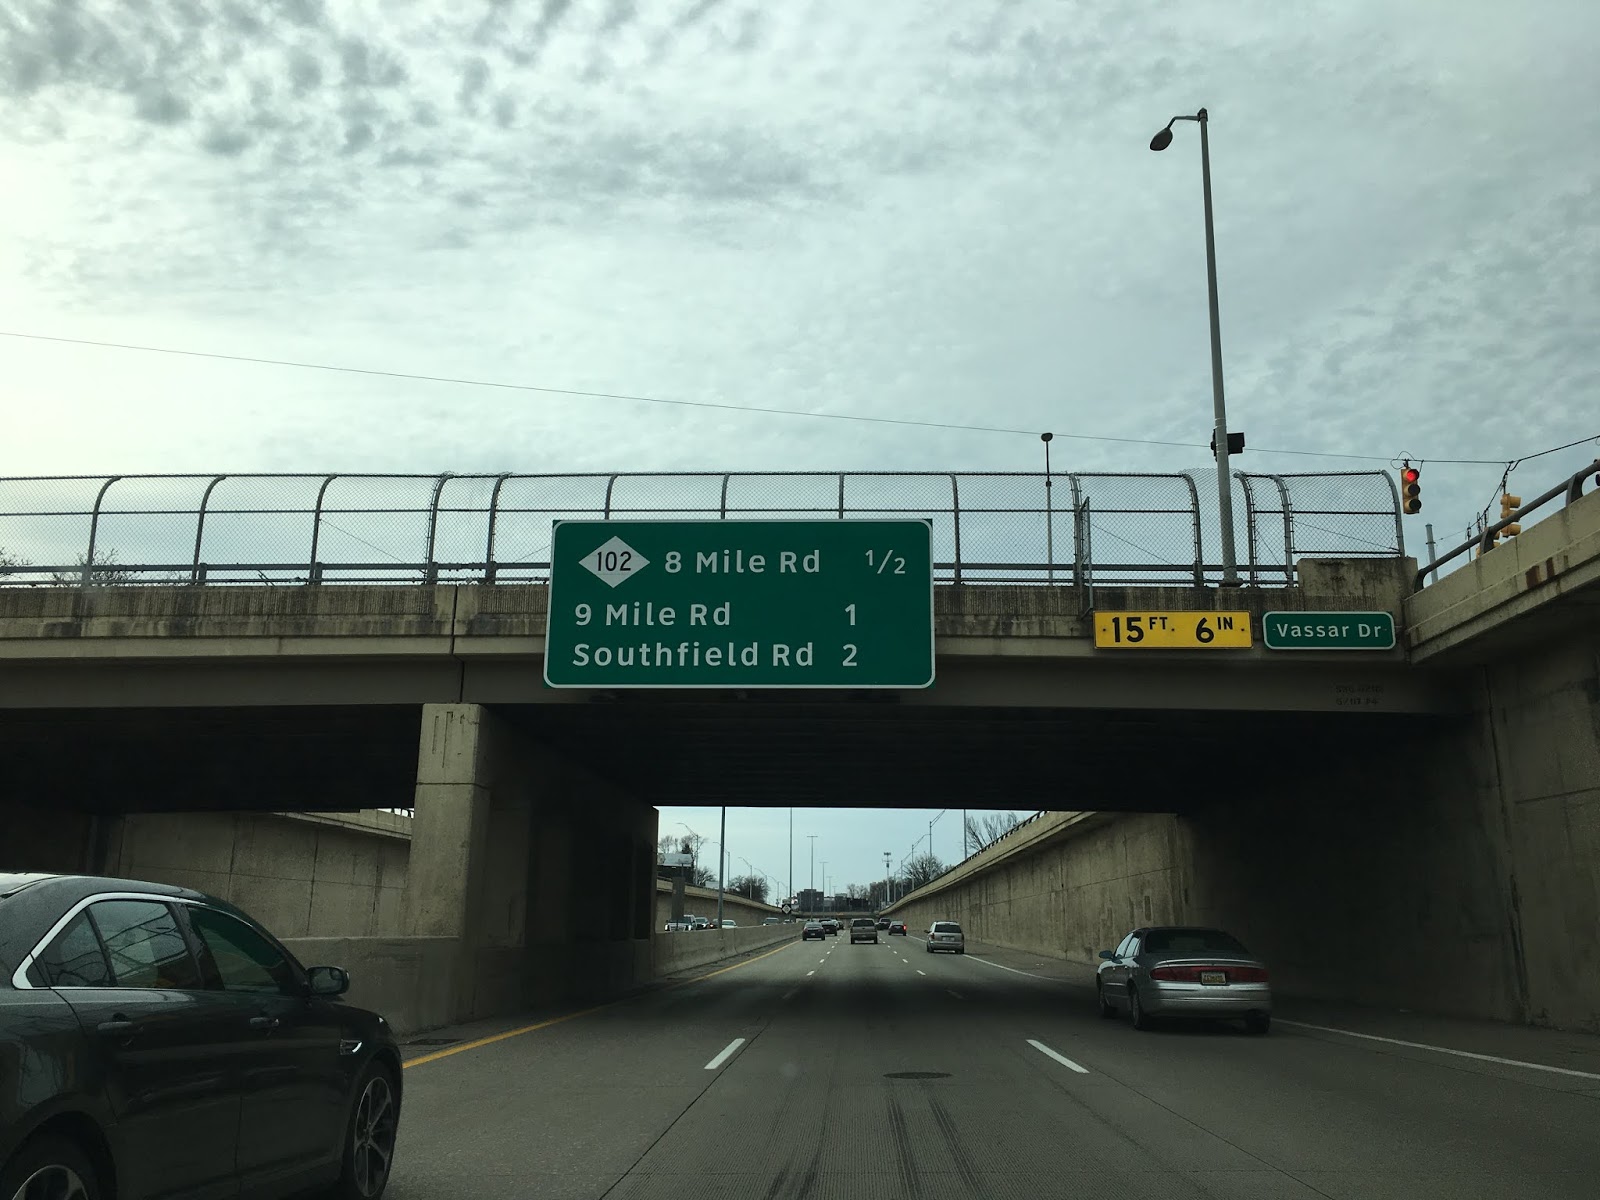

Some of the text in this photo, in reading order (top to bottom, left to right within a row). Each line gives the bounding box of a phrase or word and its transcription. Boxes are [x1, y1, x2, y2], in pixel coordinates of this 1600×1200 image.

[594, 550, 632, 572] 102
[665, 551, 682, 574] 8
[696, 550, 766, 574] Mile
[780, 550, 821, 573] Rd
[575, 602, 857, 626] 9 Mile Rd 1
[1112, 616, 1234, 643] 15 FT 6 IN
[1276, 623, 1382, 638] Vassar Dr
[573, 642, 858, 667] Southfield Rd 2
